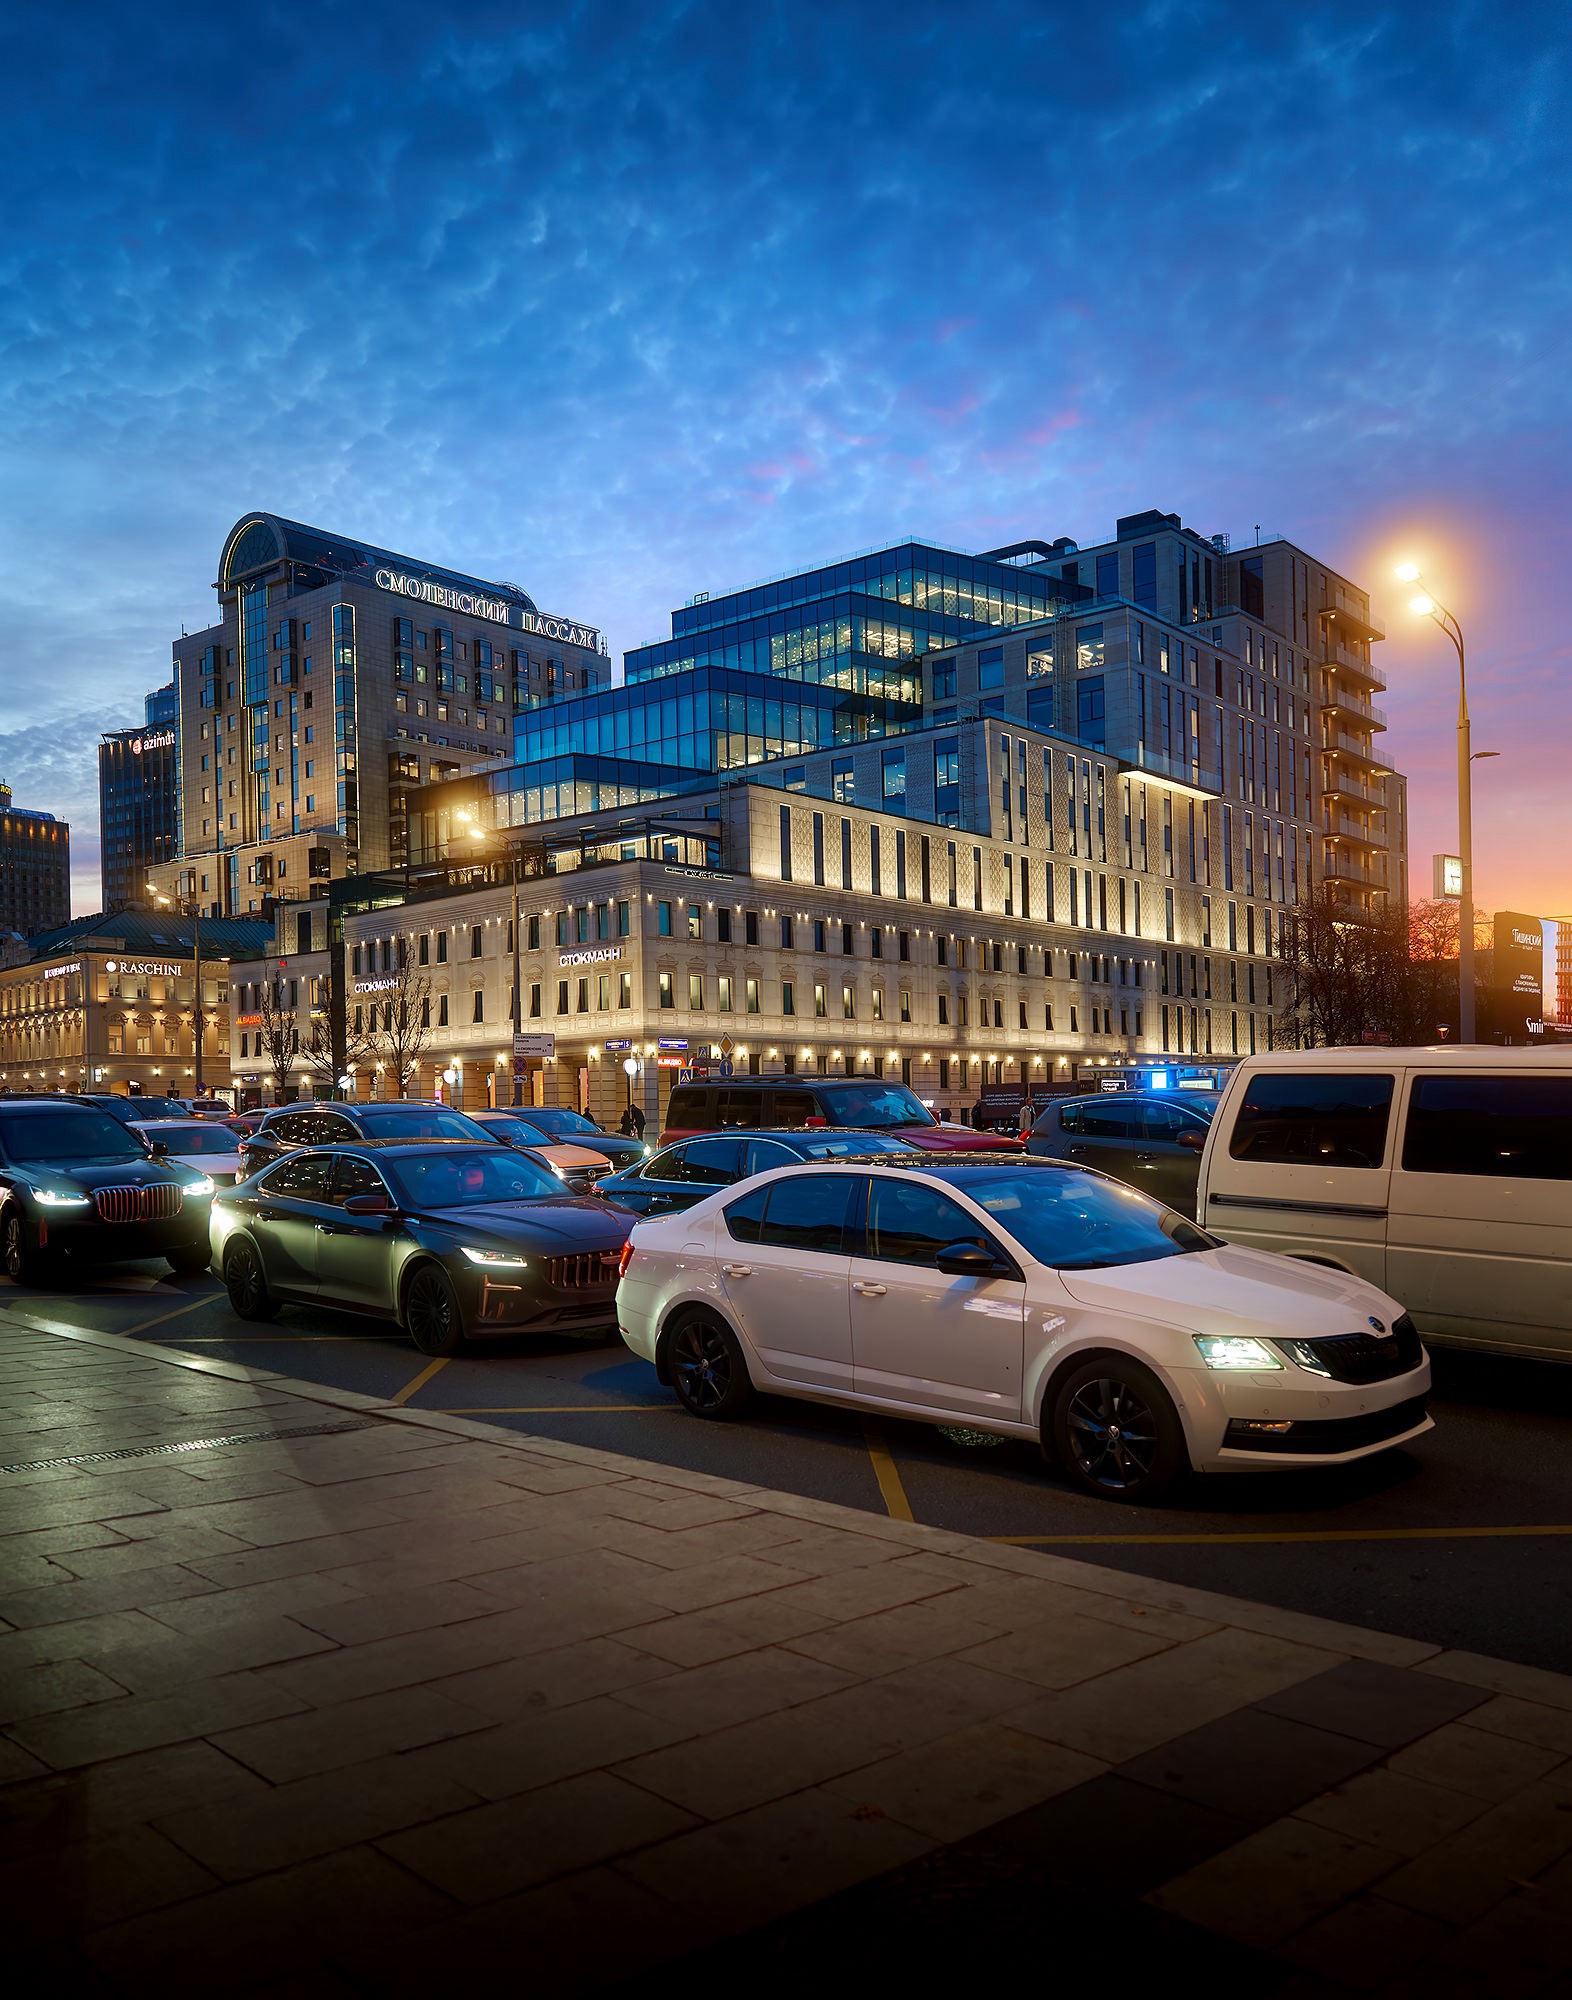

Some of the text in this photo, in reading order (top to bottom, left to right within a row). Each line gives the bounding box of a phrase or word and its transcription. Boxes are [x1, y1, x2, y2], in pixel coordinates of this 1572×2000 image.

[375, 569, 595, 650] СМОЛЕНСКИЙ ПАССАЖ
[143, 731, 176, 751] azimut
[559, 948, 622, 967] СТОКМАНН
[119, 961, 182, 977] RASCHINI
[354, 978, 400, 994] СТОКМАНН
